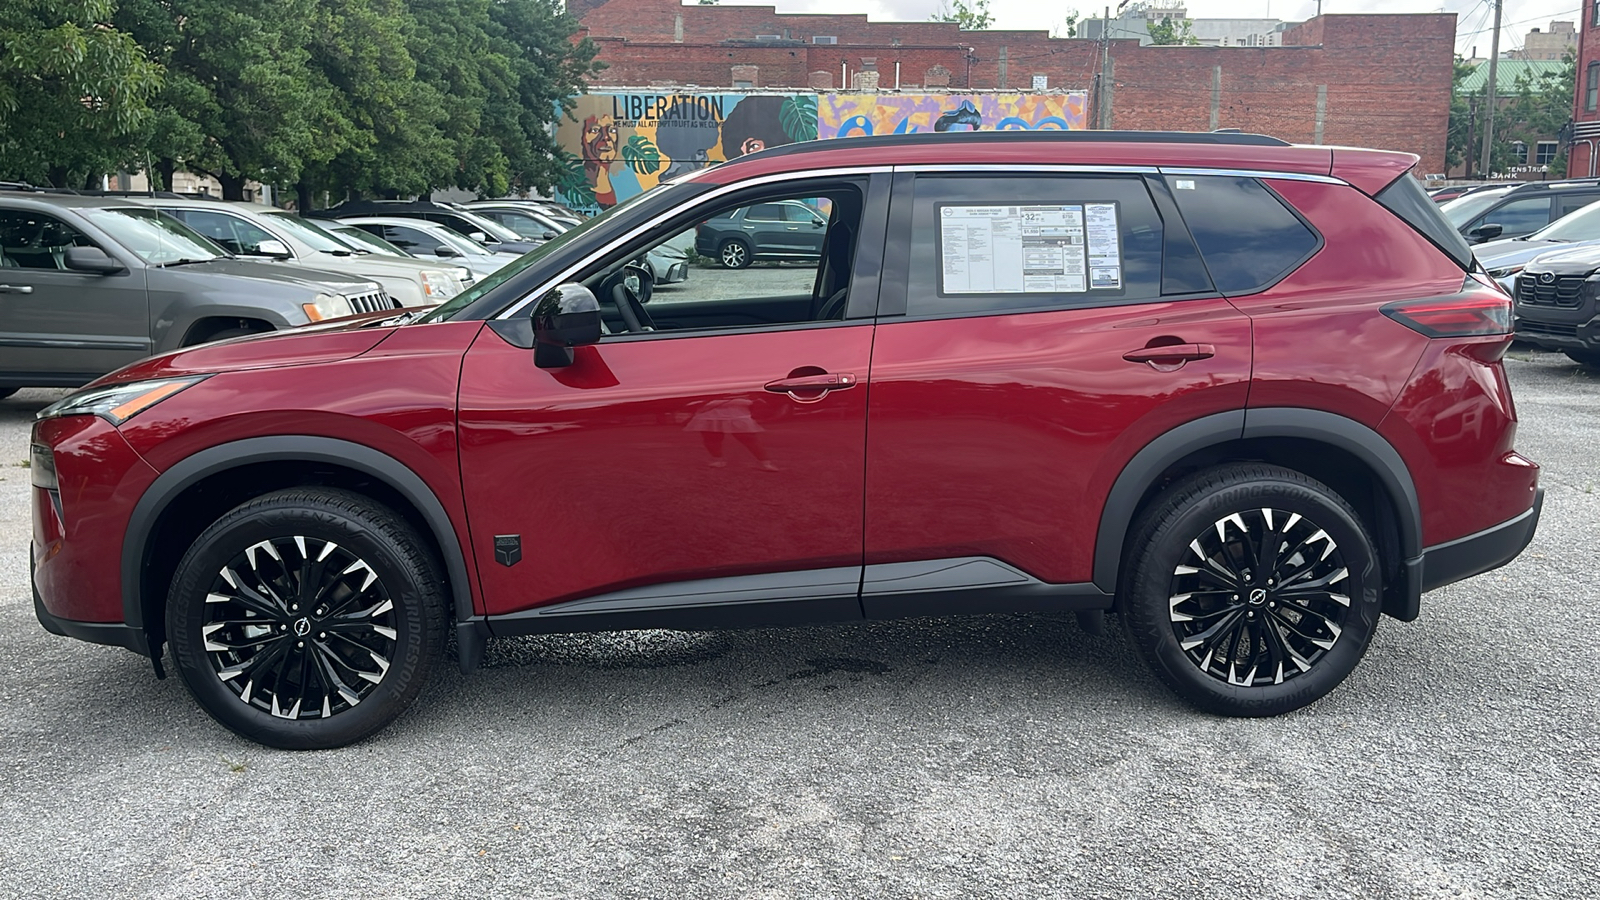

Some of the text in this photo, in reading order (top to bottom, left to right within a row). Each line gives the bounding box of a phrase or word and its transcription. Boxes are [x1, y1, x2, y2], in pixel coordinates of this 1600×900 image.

[613, 95, 724, 120] LIBERATION
[1025, 213, 1035, 221] 32
[389, 591, 421, 700] BRIDGESTONE
